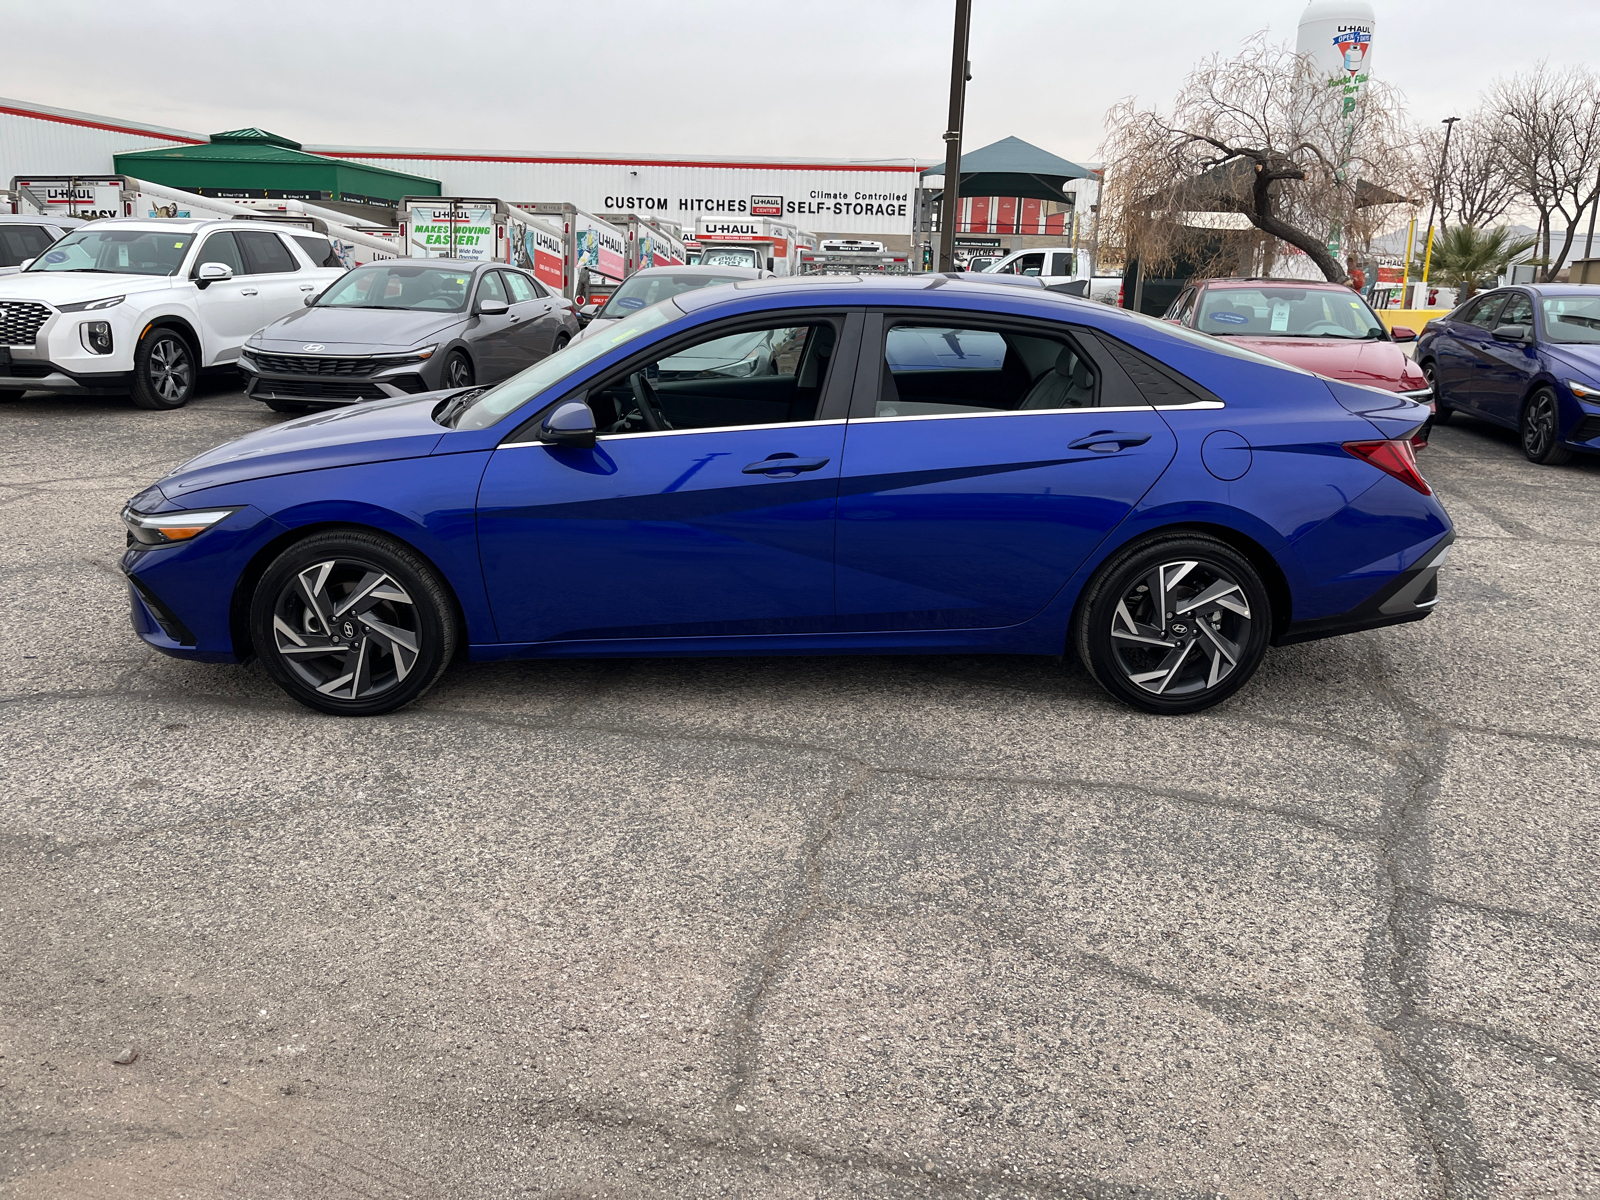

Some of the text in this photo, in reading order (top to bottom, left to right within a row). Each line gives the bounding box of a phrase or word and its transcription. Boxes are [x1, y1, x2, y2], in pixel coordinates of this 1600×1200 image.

[1337, 25, 1370, 33] U-HAUL
[1338, 33, 1354, 42] OPEN
[47, 189, 94, 199] U-HAUL
[810, 190, 907, 201] Climate Controlled
[604, 196, 747, 212] CUSTOM HITCHES
[786, 201, 907, 216] SELF-STORAGE
[433, 211, 469, 219] U-HAUL
[414, 225, 491, 235] MAKES MOVING
[705, 224, 758, 234] U-HAUL
[536, 232, 560, 254] U-HAUL
[598, 231, 623, 255] U-HAUL
[653, 239, 669, 259] U-HAUL
[967, 248, 996, 256] HITCHES
[713, 255, 749, 263] LOWEST
